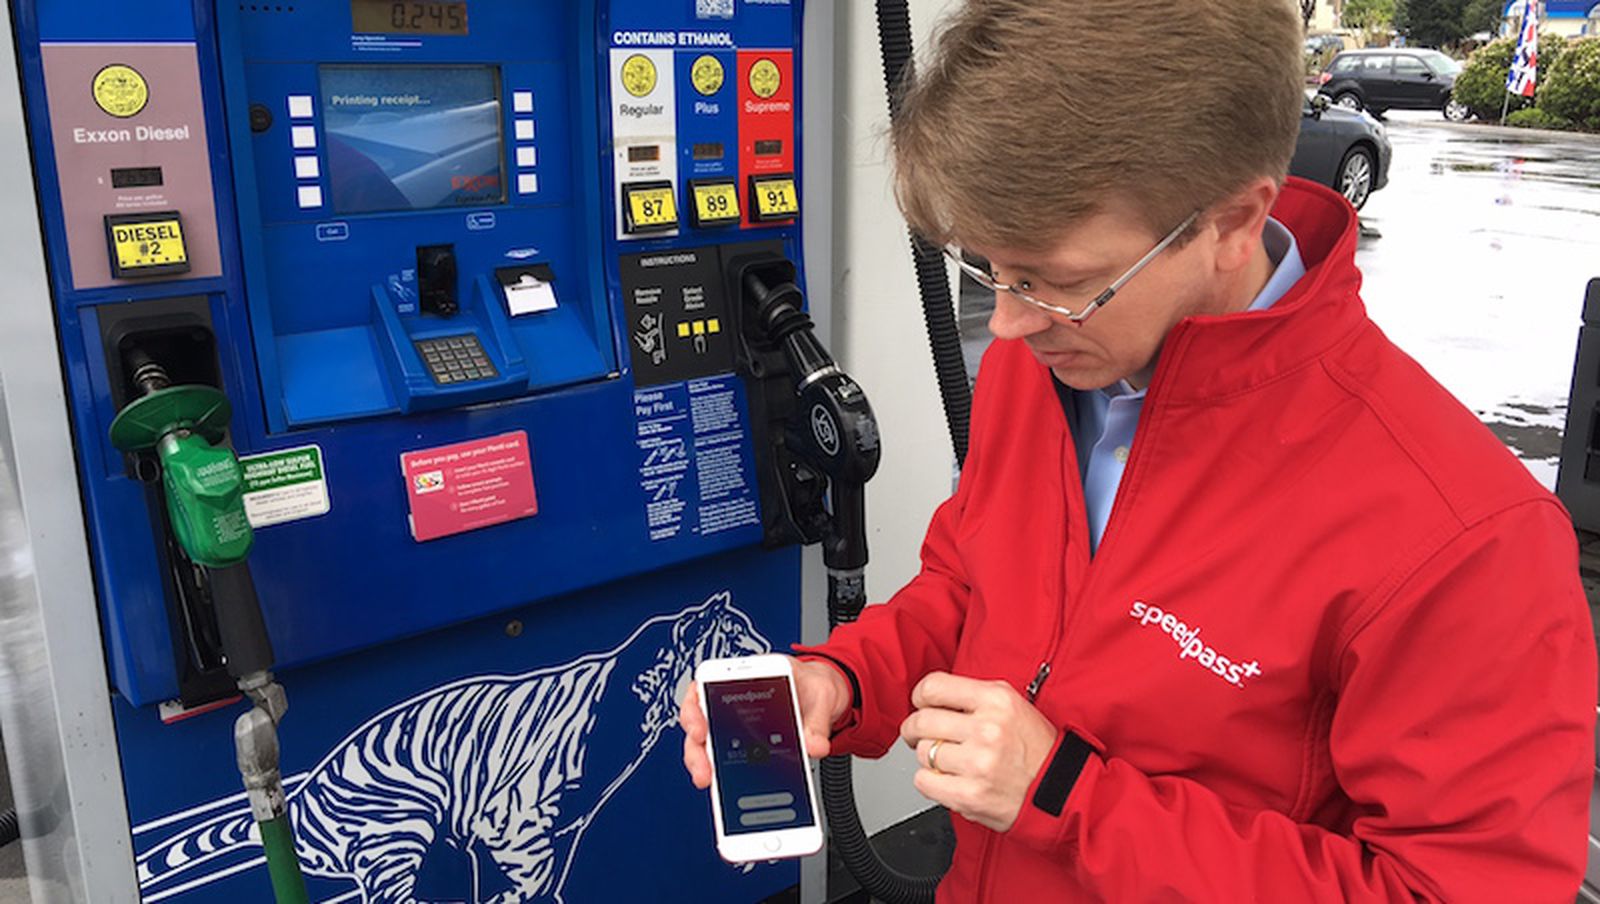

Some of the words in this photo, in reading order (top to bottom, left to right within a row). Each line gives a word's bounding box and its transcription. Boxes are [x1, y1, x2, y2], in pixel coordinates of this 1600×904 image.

[613, 31, 676, 46] CONTAINS
[678, 32, 734, 46] ETHANOL
[332, 95, 378, 107] Printing
[695, 102, 719, 114] Plus
[745, 101, 791, 115] Supreme
[619, 104, 664, 118] Regular
[73, 127, 131, 143] Exxon
[135, 125, 190, 142] Diesel
[706, 195, 728, 213] 89
[767, 190, 788, 207] 91
[642, 199, 664, 218] 87
[116, 226, 179, 243] DIESEL
[640, 254, 696, 267] INSTRUCTIONS
[634, 391, 664, 404] Please
[654, 401, 674, 413] First
